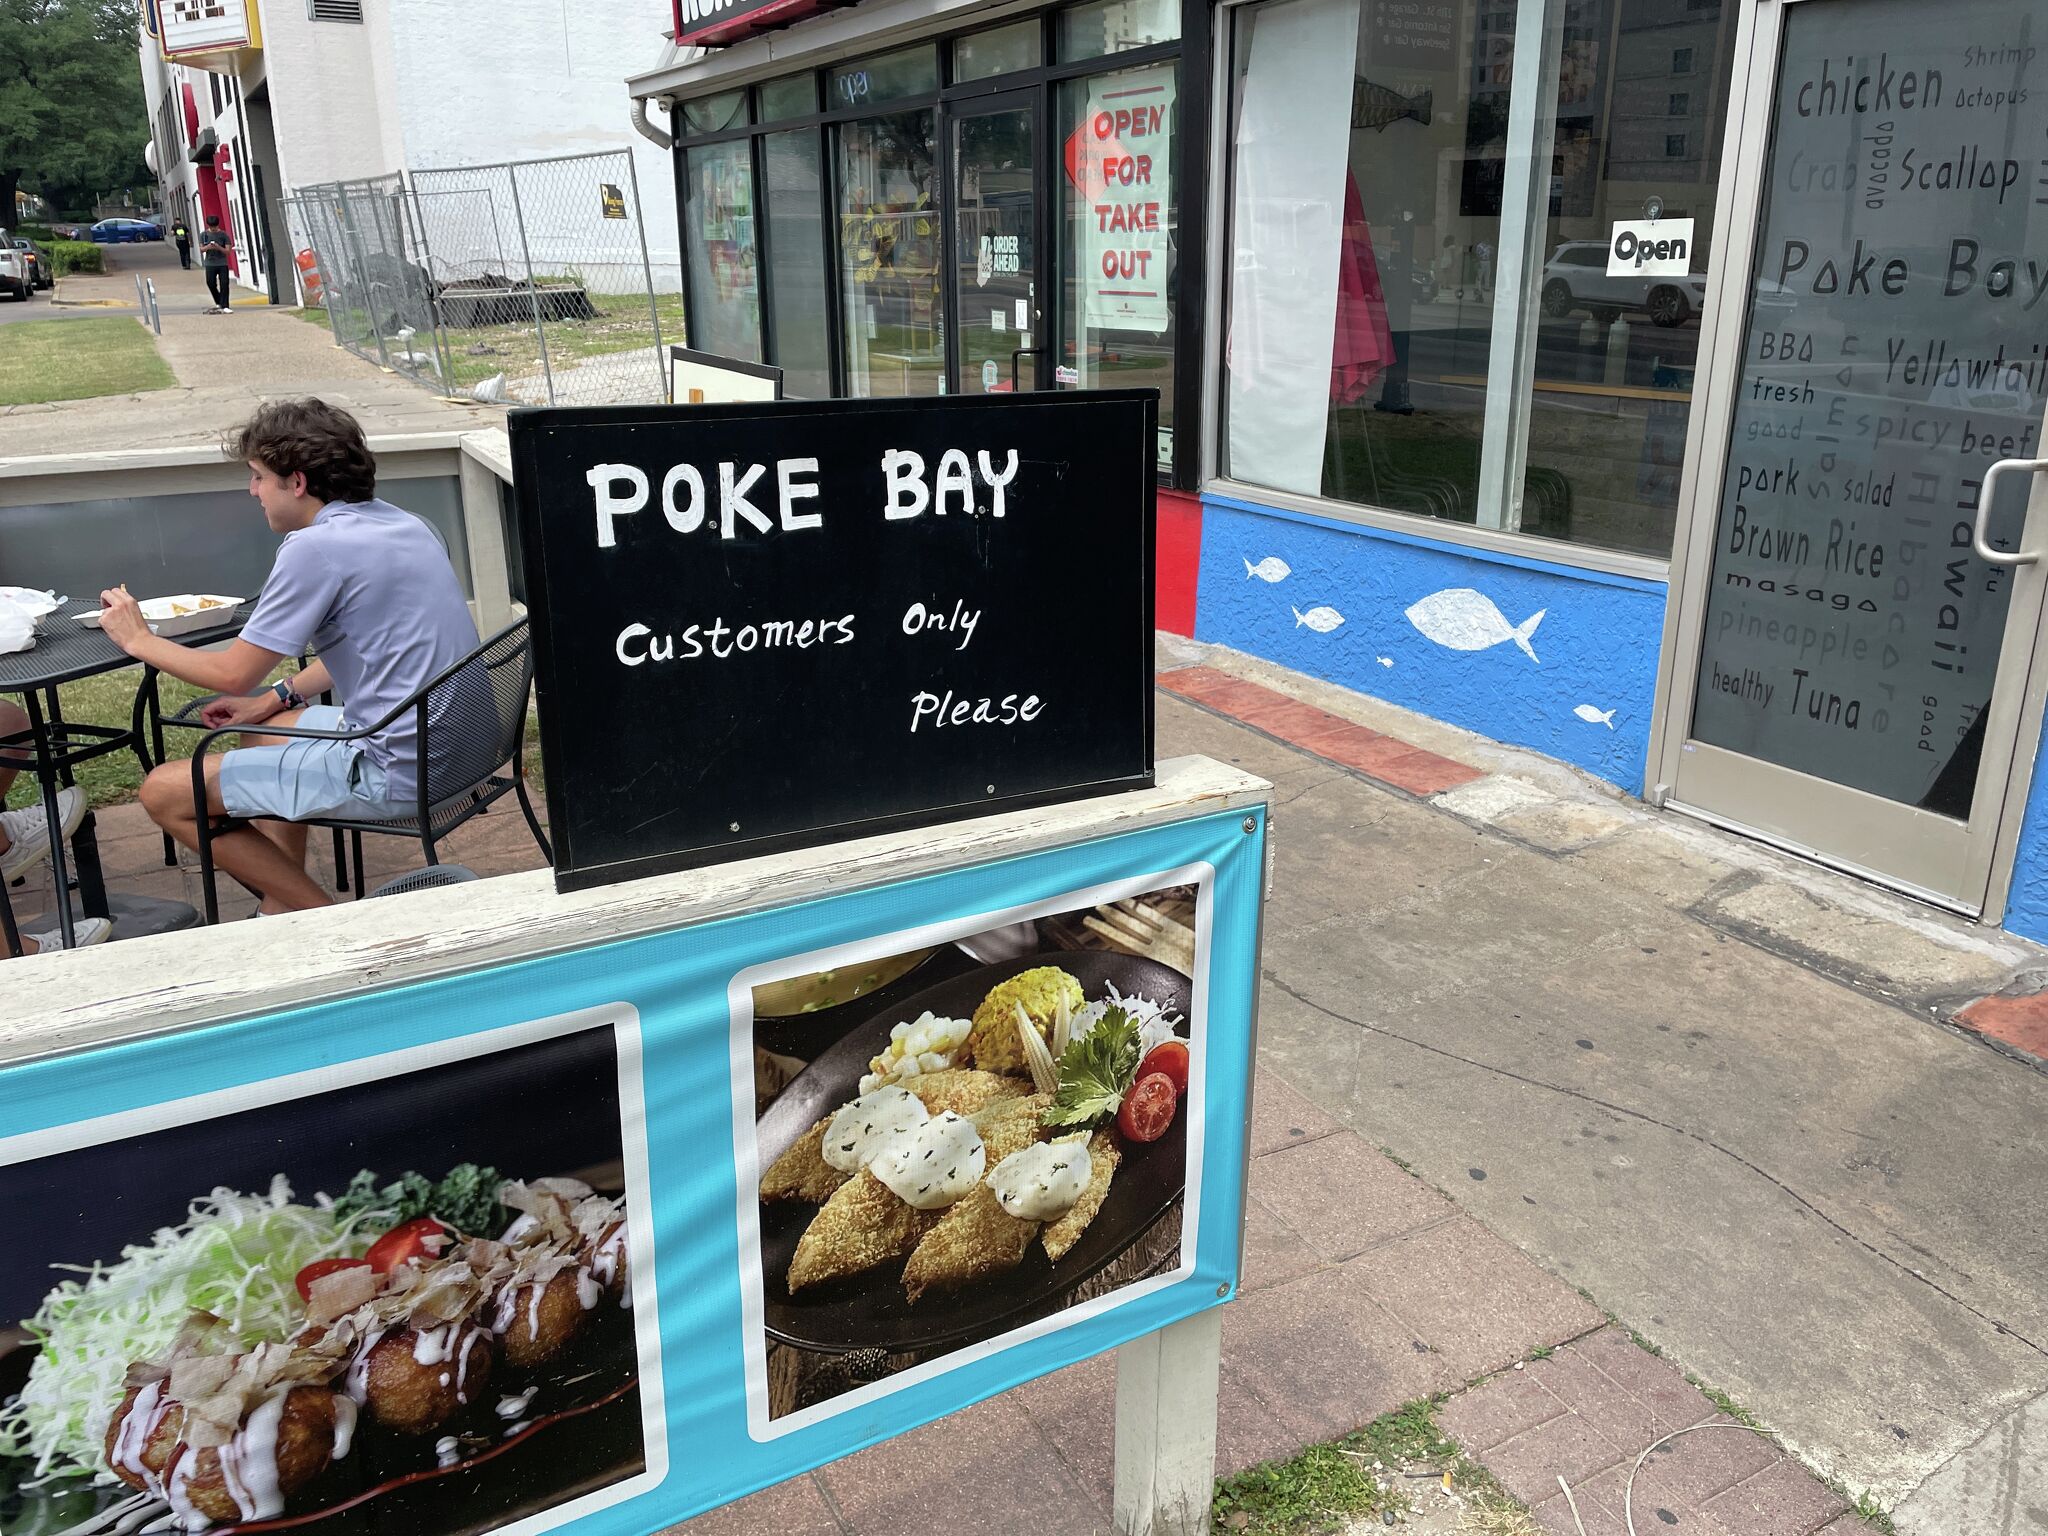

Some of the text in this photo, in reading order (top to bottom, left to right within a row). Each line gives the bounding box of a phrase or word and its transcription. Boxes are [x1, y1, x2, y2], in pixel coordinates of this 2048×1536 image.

[1964, 42, 2037, 69] Shrimp
[1797, 52, 1943, 117] chicken
[1955, 86, 2029, 113] Octopus
[1094, 104, 1166, 141] OPEN
[1103, 154, 1153, 187] FOR
[1788, 150, 1857, 193] Crab
[1900, 144, 2020, 204] Scallop
[1864, 120, 1895, 209] avocado
[1094, 202, 1161, 233] TAKE
[993, 235, 1019, 254] ORDER
[993, 254, 1020, 272] AHEAD
[1101, 249, 1153, 281] OUT
[1615, 231, 1686, 268] Open
[1777, 238, 2048, 312] Poke Bay
[1886, 337, 2048, 394] Yellowtail
[1753, 376, 1815, 404] fresh
[1747, 415, 1802, 441] good
[1856, 405, 1951, 451] spicy
[1960, 419, 2034, 459] beef
[586, 447, 1018, 547] POKE BAY
[1737, 458, 1798, 502] pork
[1843, 470, 1896, 508] salad
[1730, 504, 1884, 579] Brown Rice
[1986, 537, 2011, 593] tfu
[1726, 572, 1878, 612] masago
[615, 599, 982, 667] Customers Only
[1719, 601, 1869, 665] pineapple
[911, 690, 1047, 733] Please
[1711, 660, 1861, 731] healthy Tuna
[1918, 695, 1938, 752] good
